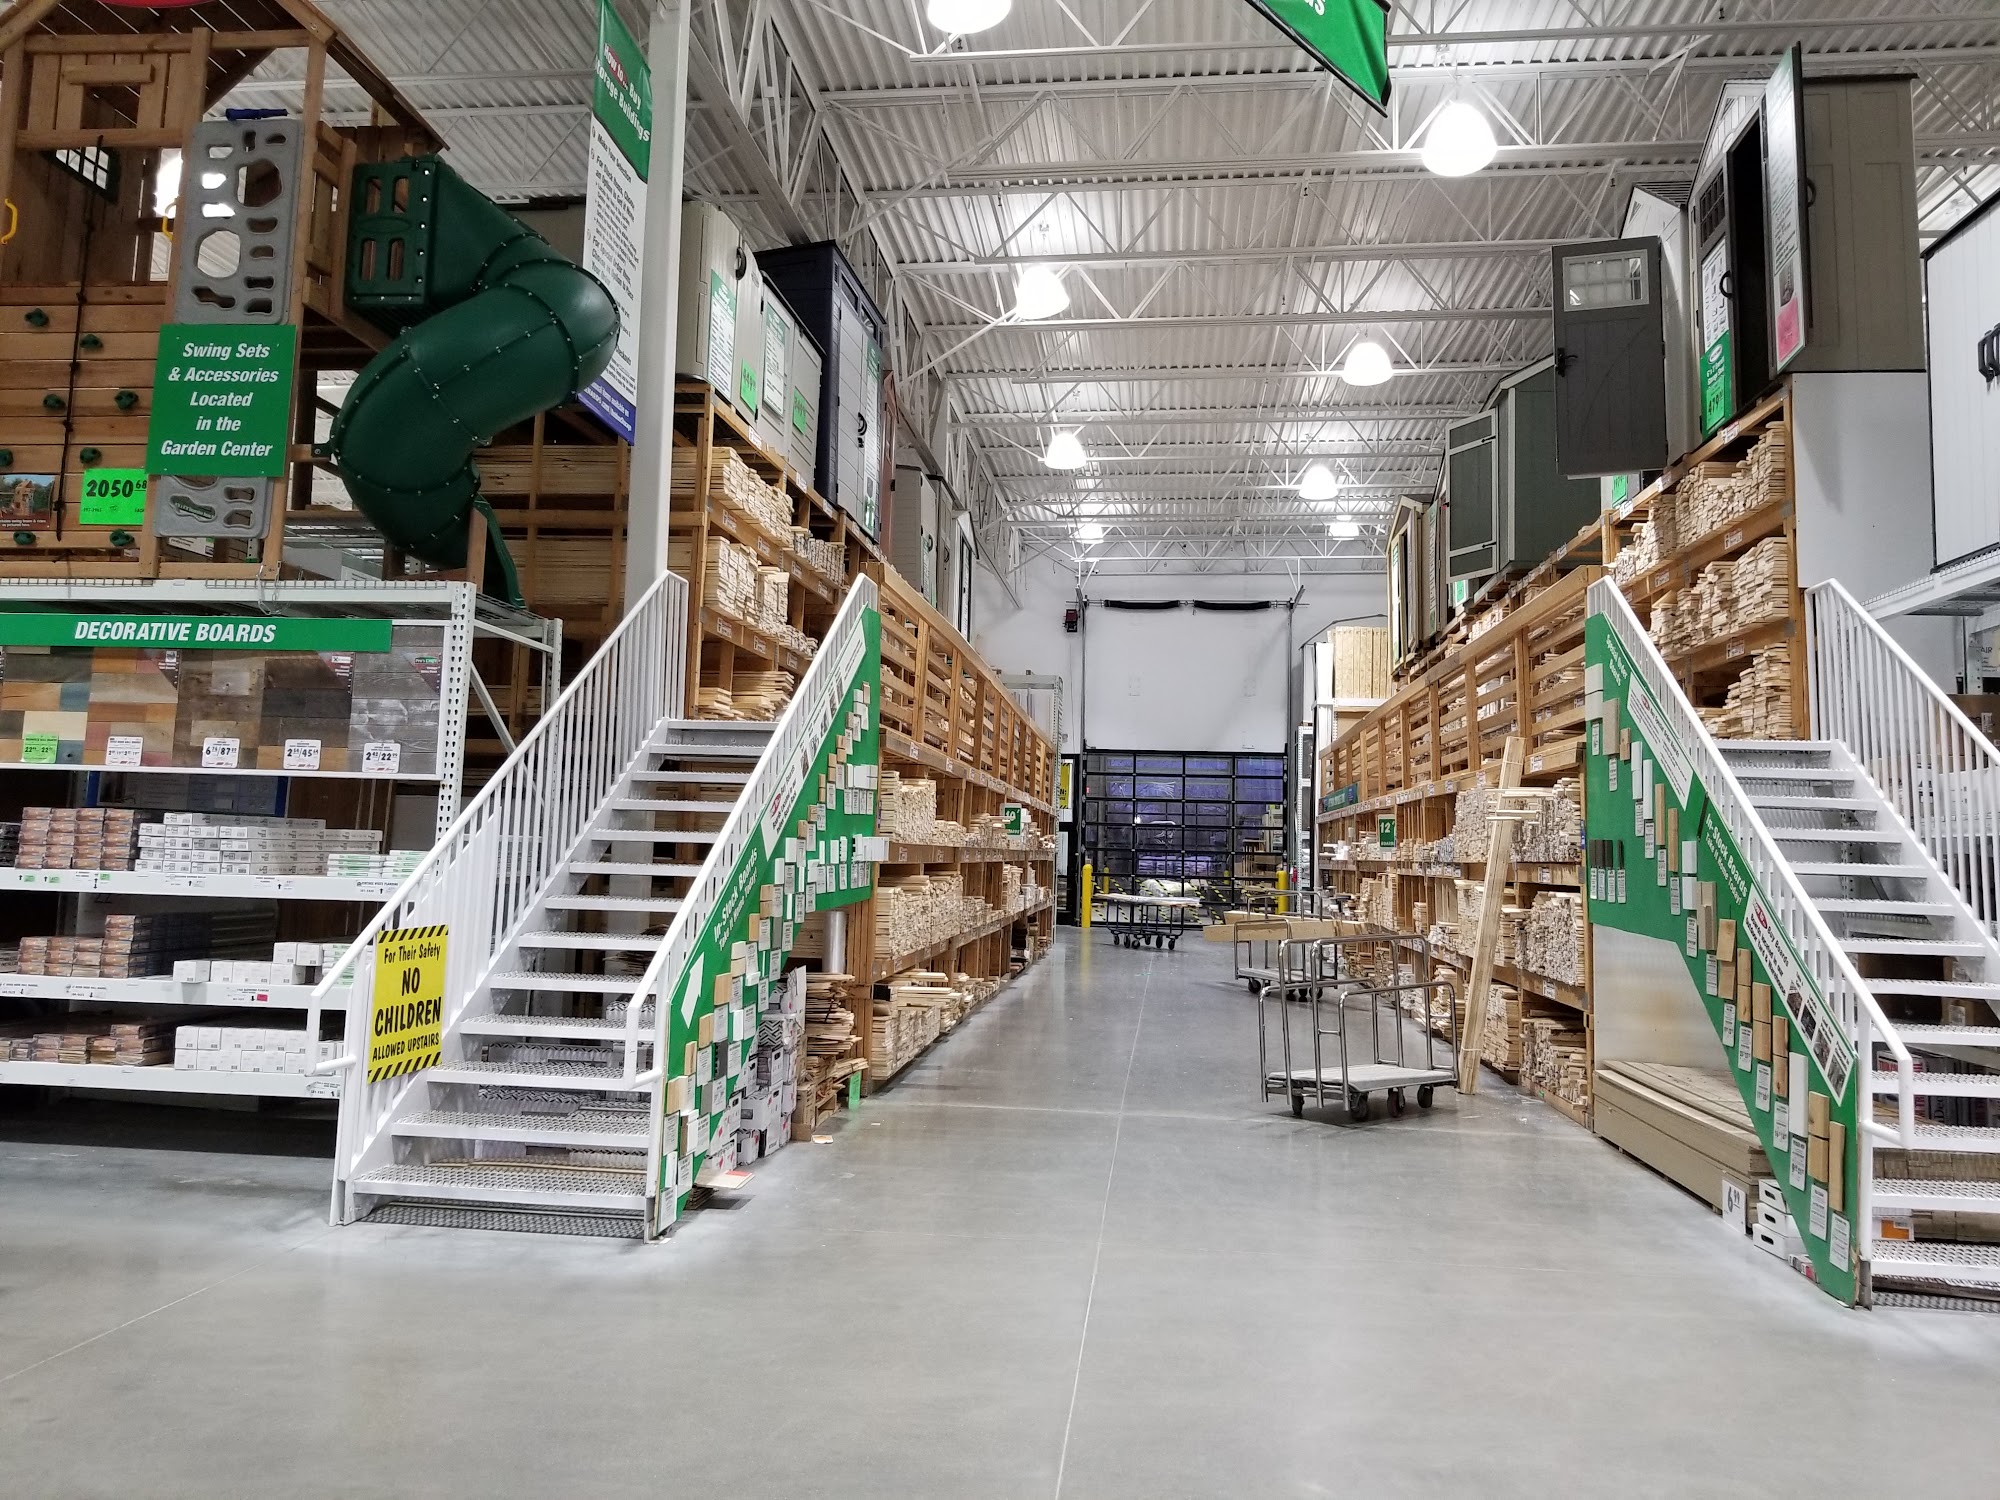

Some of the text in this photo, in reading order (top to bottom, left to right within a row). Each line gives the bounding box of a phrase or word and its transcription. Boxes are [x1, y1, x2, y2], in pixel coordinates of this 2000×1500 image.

[604, 43, 617, 71] How
[629, 82, 641, 110] Buy
[619, 91, 650, 142] Buildings
[183, 342, 271, 361] Swing Sets
[168, 366, 279, 383] & Accessories
[190, 391, 254, 407] Located
[195, 416, 241, 431] in the
[161, 439, 273, 457] Garden Center
[86, 479, 134, 498] 2050
[75, 621, 277, 643] DECORATIVE BOARDS
[1606, 633, 1628, 680] Special Order
[1609, 658, 1621, 687] Boards
[205, 746, 211, 755] 6
[220, 747, 231, 755] 87
[287, 748, 293, 757] 2
[302, 749, 313, 757] 45
[366, 752, 371, 760] 2
[1706, 813, 1747, 898] In-Stock Boards
[1706, 832, 1715, 853] Take
[1717, 856, 1728, 881] Home
[714, 847, 758, 943] In-Stock Boards
[719, 927, 730, 952] Take
[733, 895, 744, 923] Home
[1751, 913, 1762, 937] Boards
[384, 942, 441, 964] For Their Safety
[1767, 926, 1775, 943] Buy
[1774, 940, 1789, 967] Boards
[401, 966, 420, 996] NO
[1768, 958, 1786, 996] Warehouse
[374, 996, 442, 1037] CHILDREN
[372, 1032, 440, 1062] ALLOWED UPSTAIRS
[1727, 1186, 1740, 1213] 6 99
